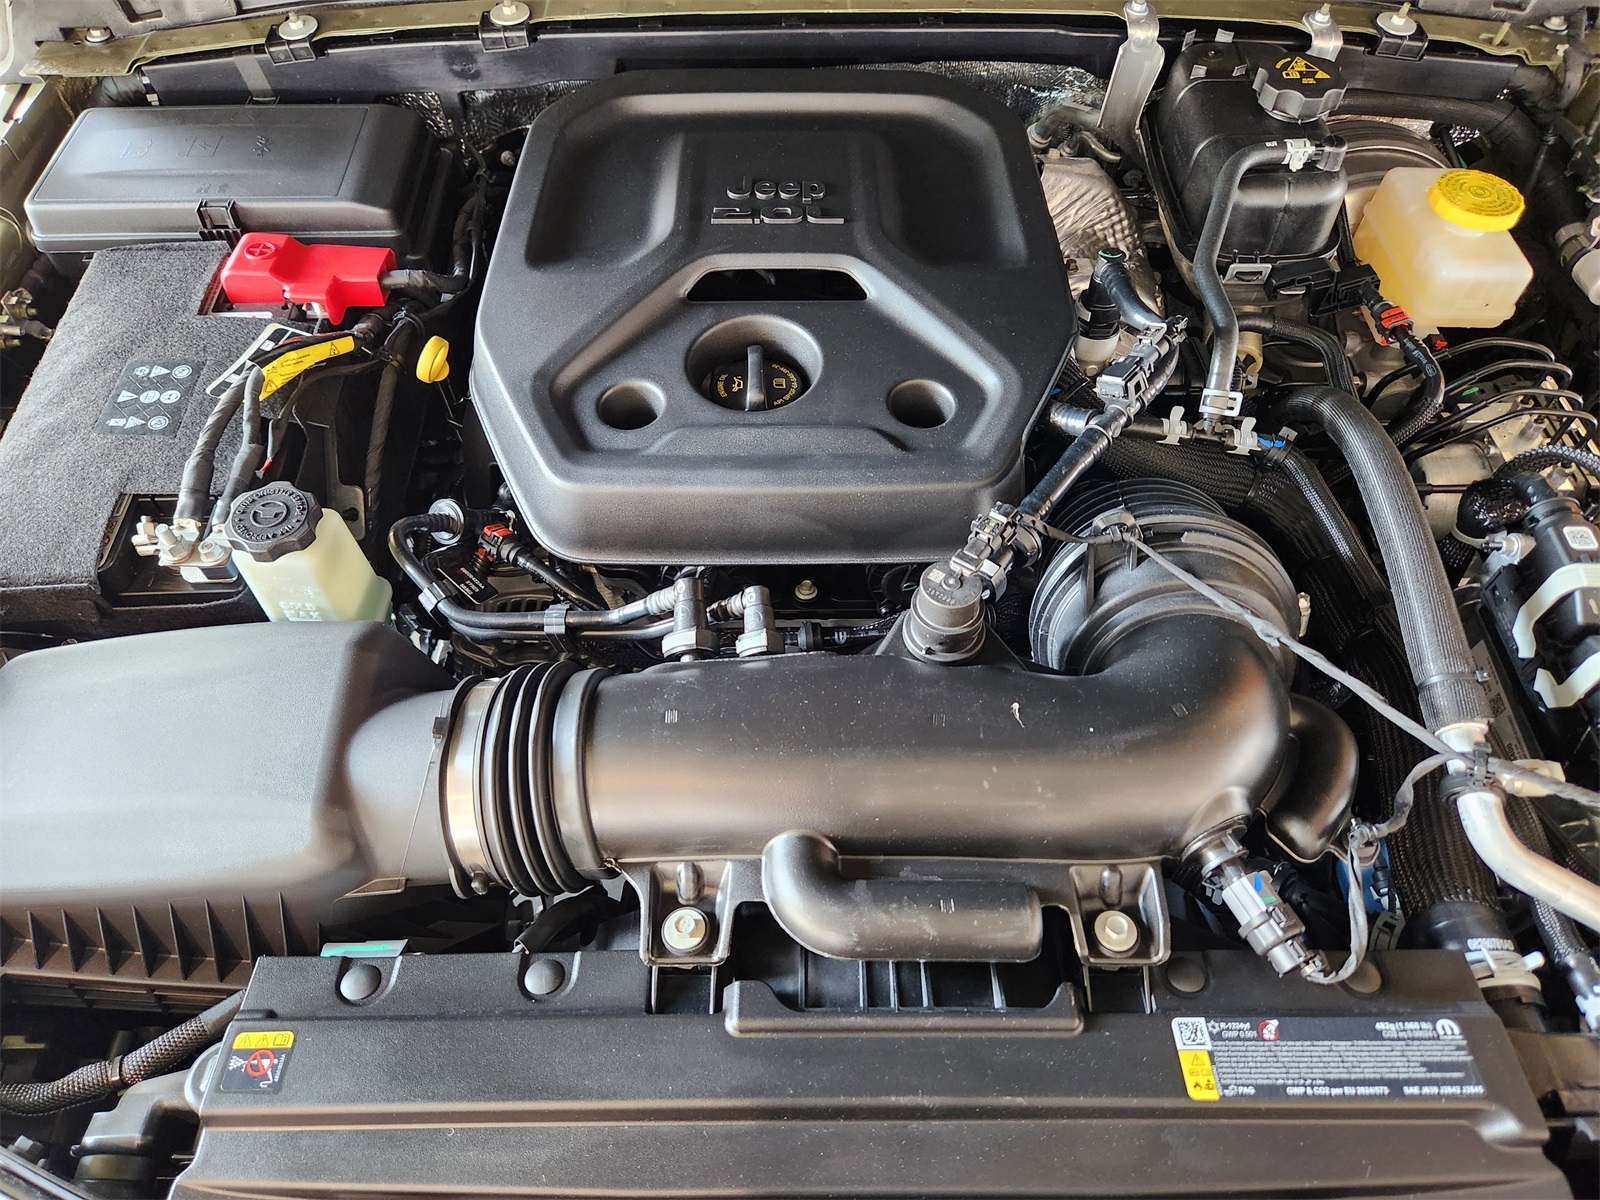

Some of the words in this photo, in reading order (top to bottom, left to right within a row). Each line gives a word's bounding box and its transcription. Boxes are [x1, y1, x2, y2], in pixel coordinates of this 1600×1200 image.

[727, 176, 826, 204] Jeep
[711, 205, 845, 225] 2.0L
[719, 373, 729, 381] OIL
[717, 381, 728, 398] ENGINE
[773, 398, 785, 406] API
[253, 488, 292, 498] STEERING
[235, 497, 253, 514] FLUID
[291, 494, 306, 516] POWER
[235, 524, 275, 540] APPROVED
[1238, 1086, 1256, 1096] PAG
[1286, 1086, 1305, 1096] GWP
[1305, 1086, 1313, 1096] &
[1313, 1086, 1330, 1096] CO2
[1330, 1087, 1343, 1097] per
[1343, 1086, 1356, 1096] EU
[1402, 1085, 1420, 1096] SAE
